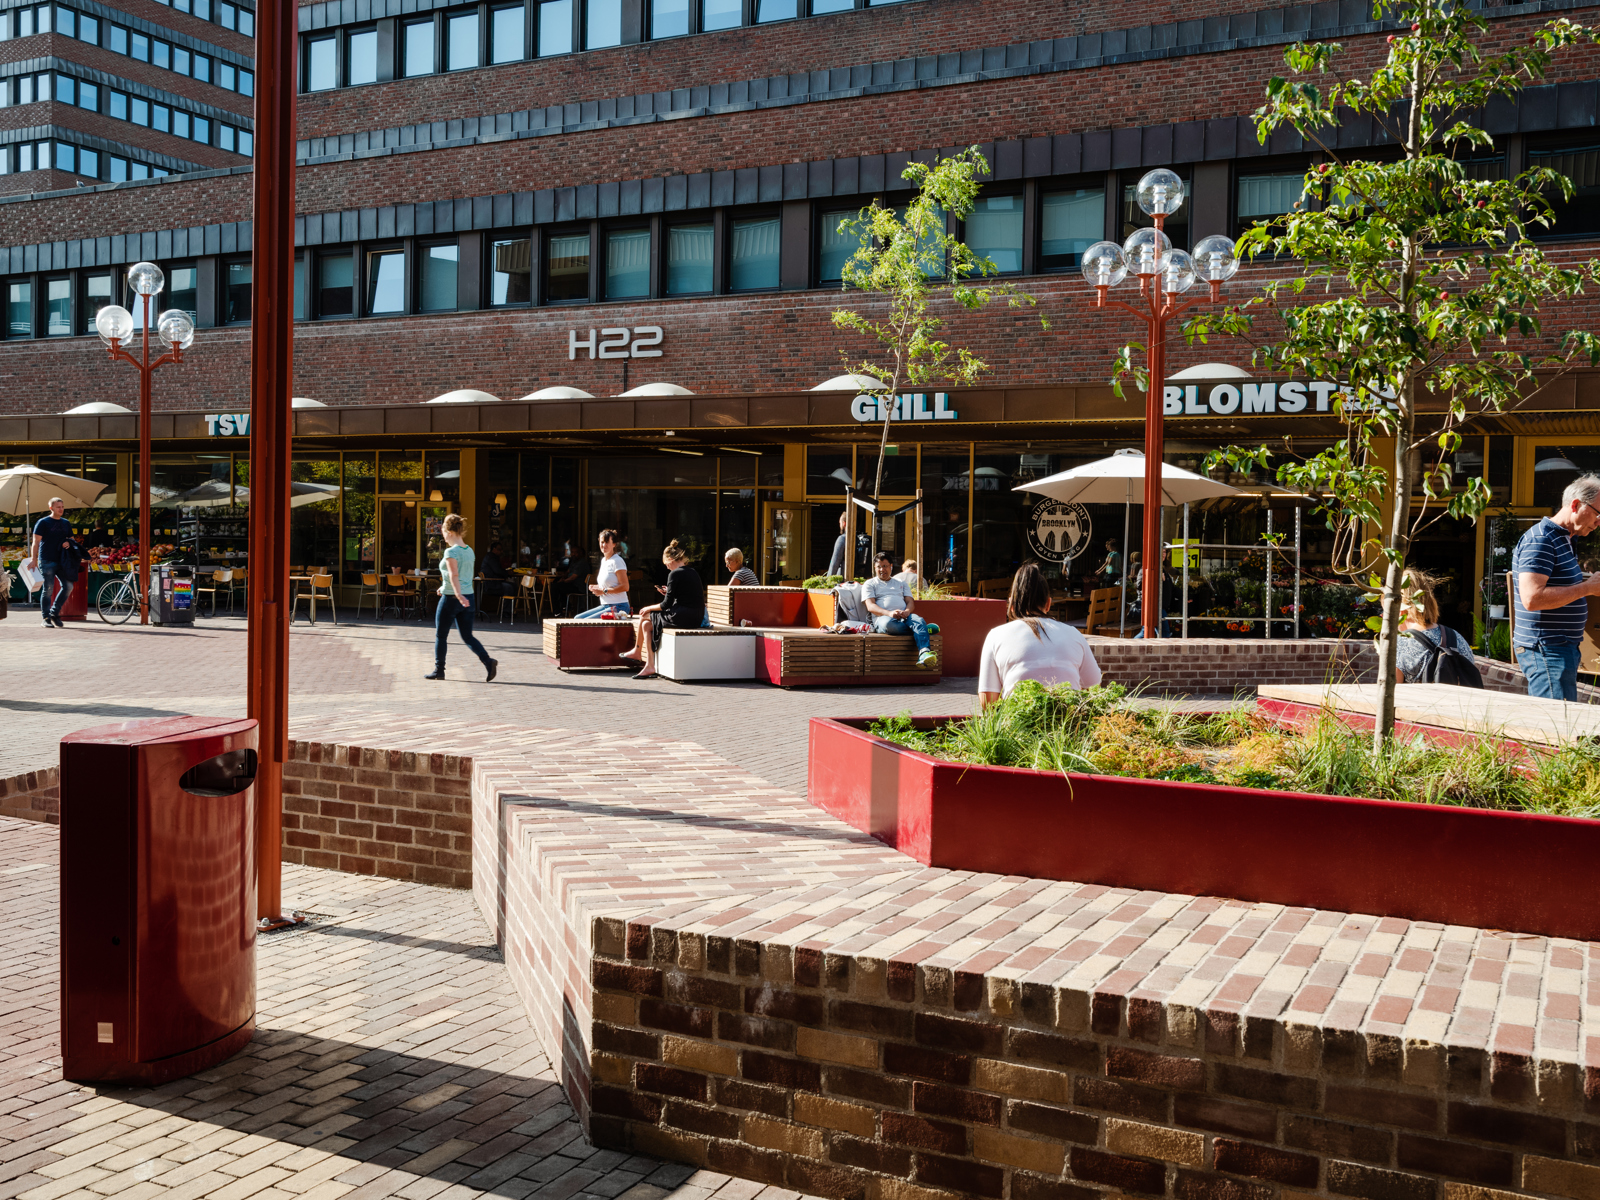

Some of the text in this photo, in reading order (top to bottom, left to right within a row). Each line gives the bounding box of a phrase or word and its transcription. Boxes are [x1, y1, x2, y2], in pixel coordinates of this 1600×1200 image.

[568, 326, 664, 361] H22
[850, 392, 958, 422] GRILL
[1041, 519, 1076, 528] BROOKLYN
[1035, 542, 1081, 559] TØYEN TORG
